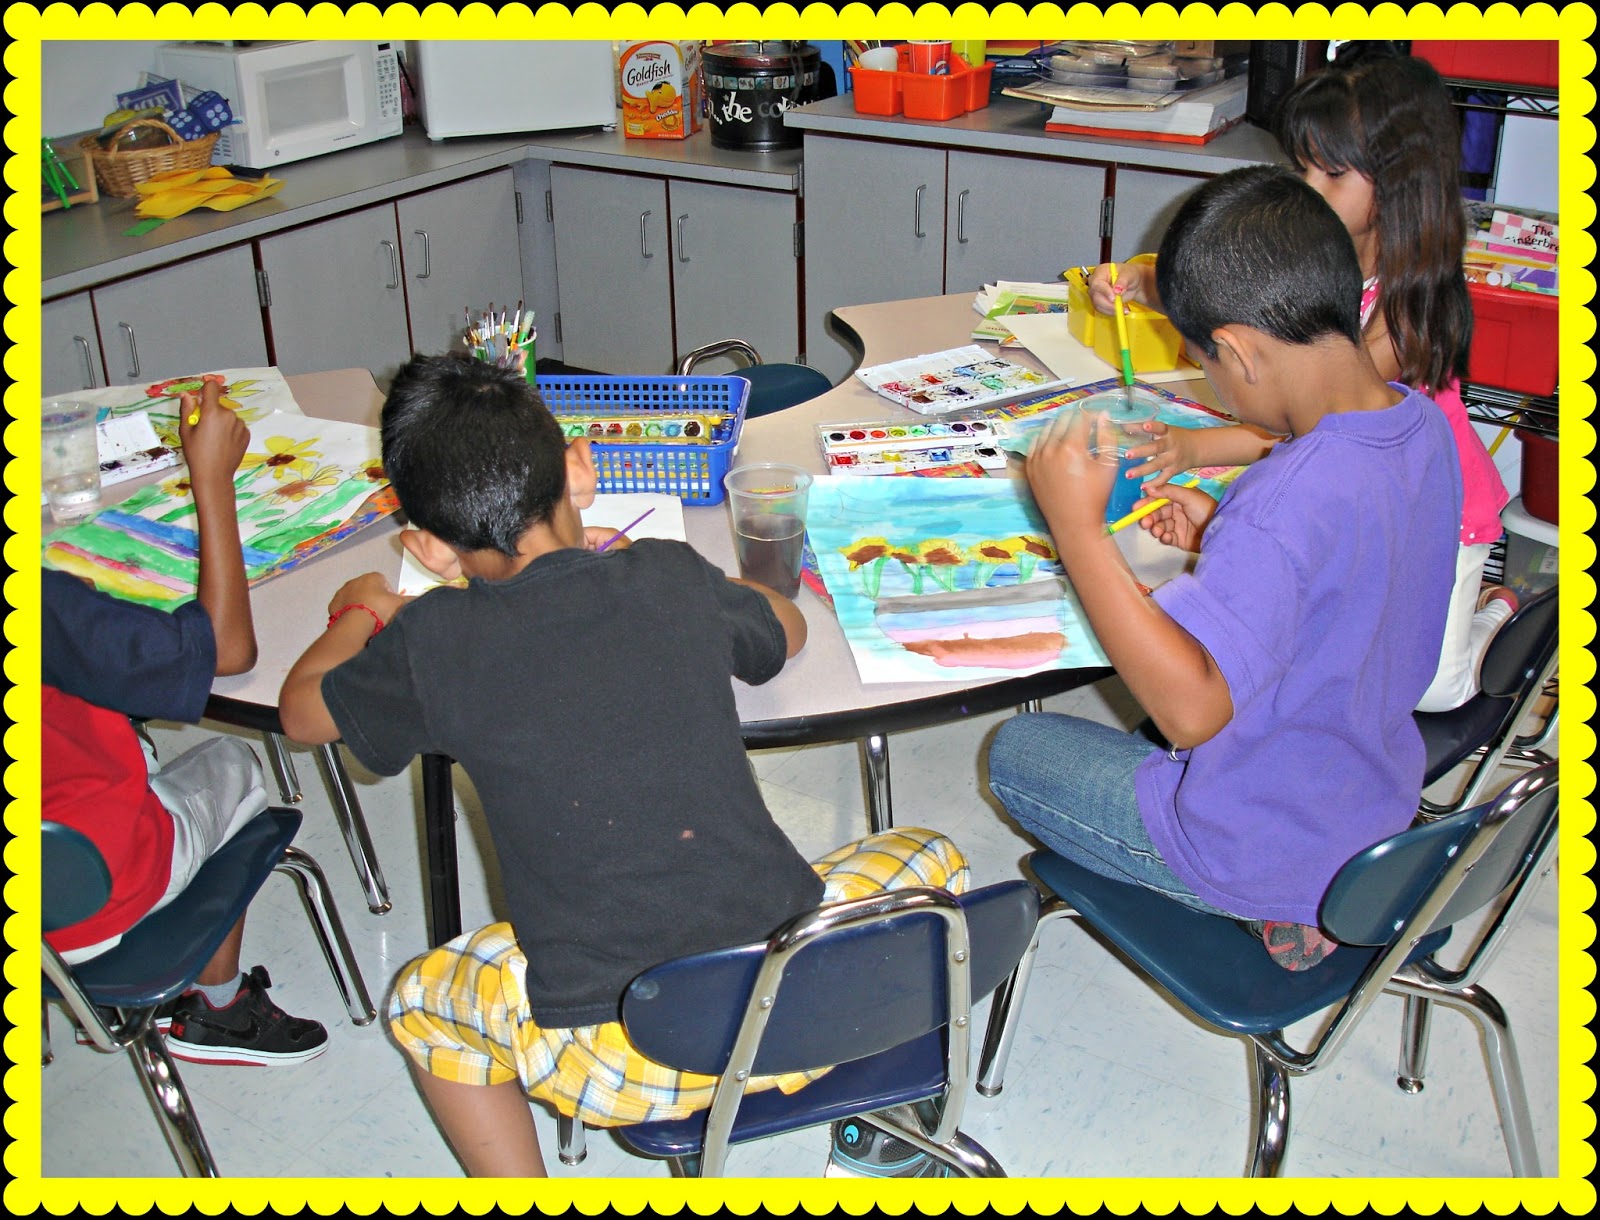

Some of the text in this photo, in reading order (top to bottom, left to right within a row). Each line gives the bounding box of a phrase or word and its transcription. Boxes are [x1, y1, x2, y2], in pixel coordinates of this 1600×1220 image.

[627, 60, 671, 86] Goldfish
[722, 91, 753, 123] the
[1531, 224, 1554, 238] The
[1505, 235, 1559, 252] ingerbre
